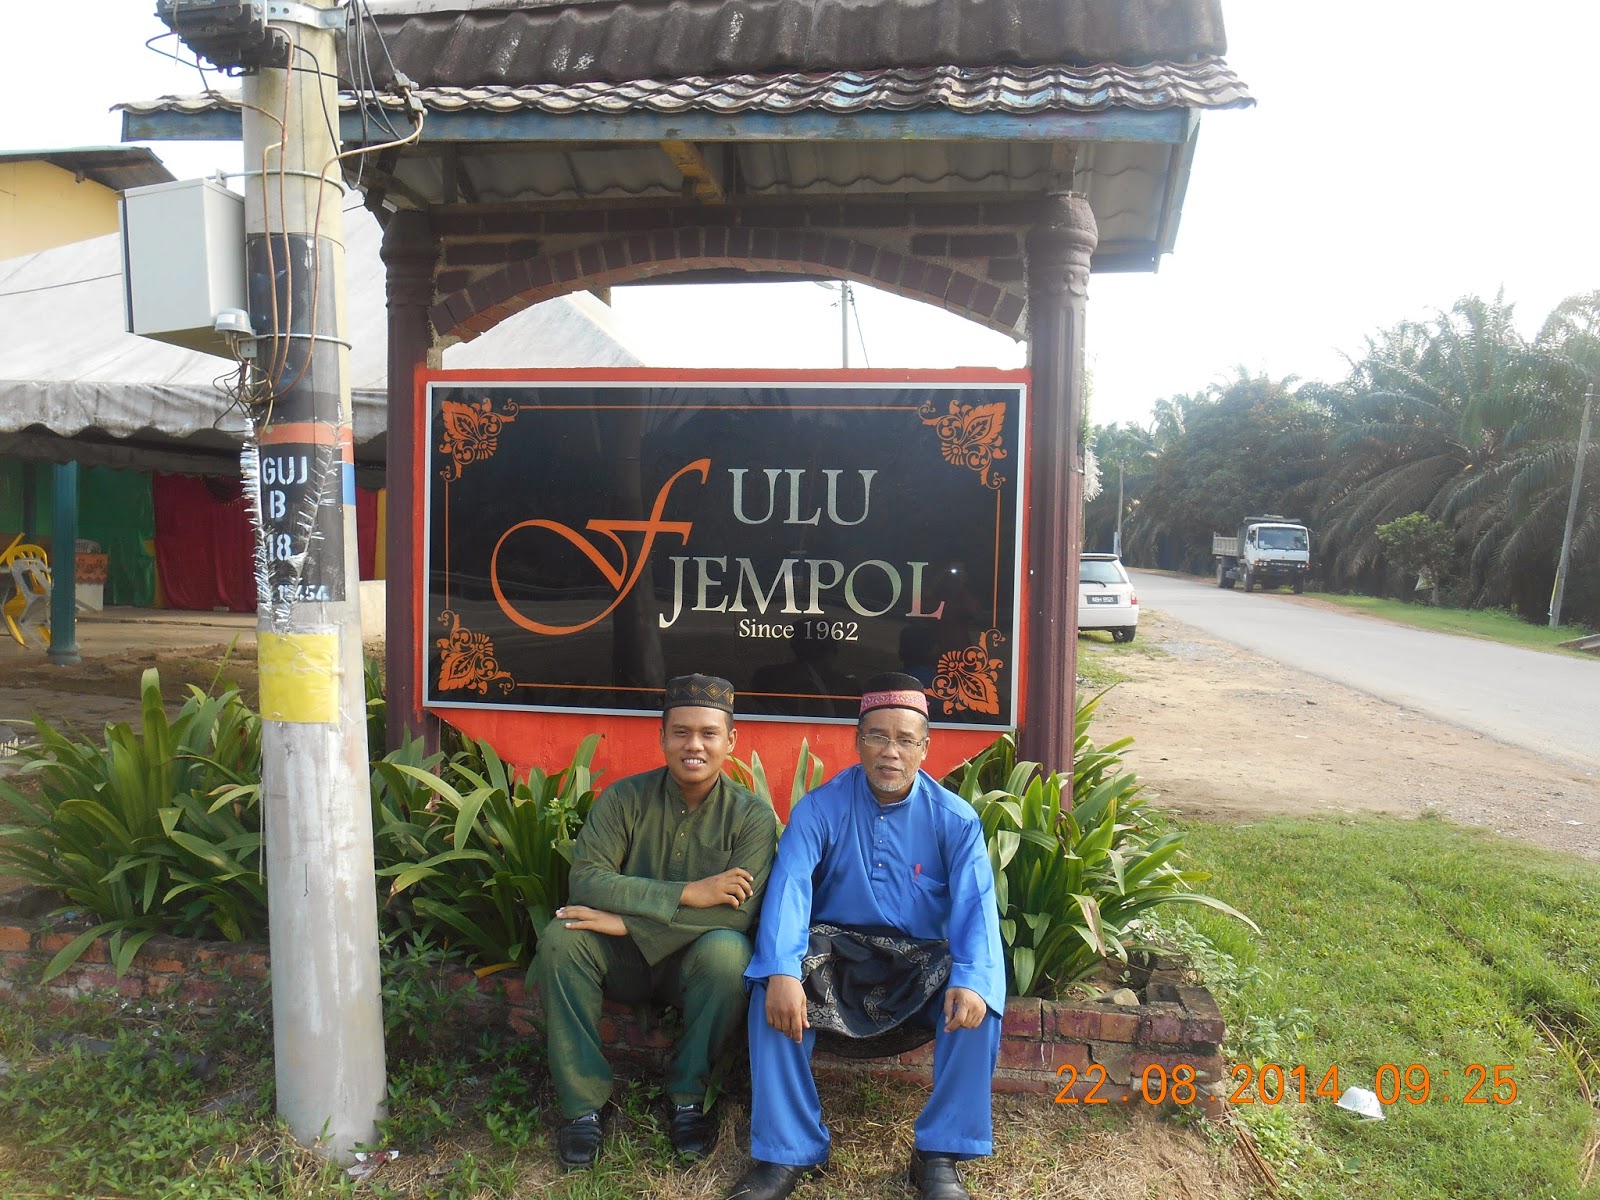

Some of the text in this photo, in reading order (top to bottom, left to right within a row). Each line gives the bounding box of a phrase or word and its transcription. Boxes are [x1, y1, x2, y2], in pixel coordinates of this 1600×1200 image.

[262, 456, 307, 485] GUJ
[270, 490, 286, 519] B
[727, 468, 877, 527] ULU
[266, 533, 292, 561] 18
[659, 555, 945, 629] JEMPOL
[738, 618, 859, 642] Since 1962
